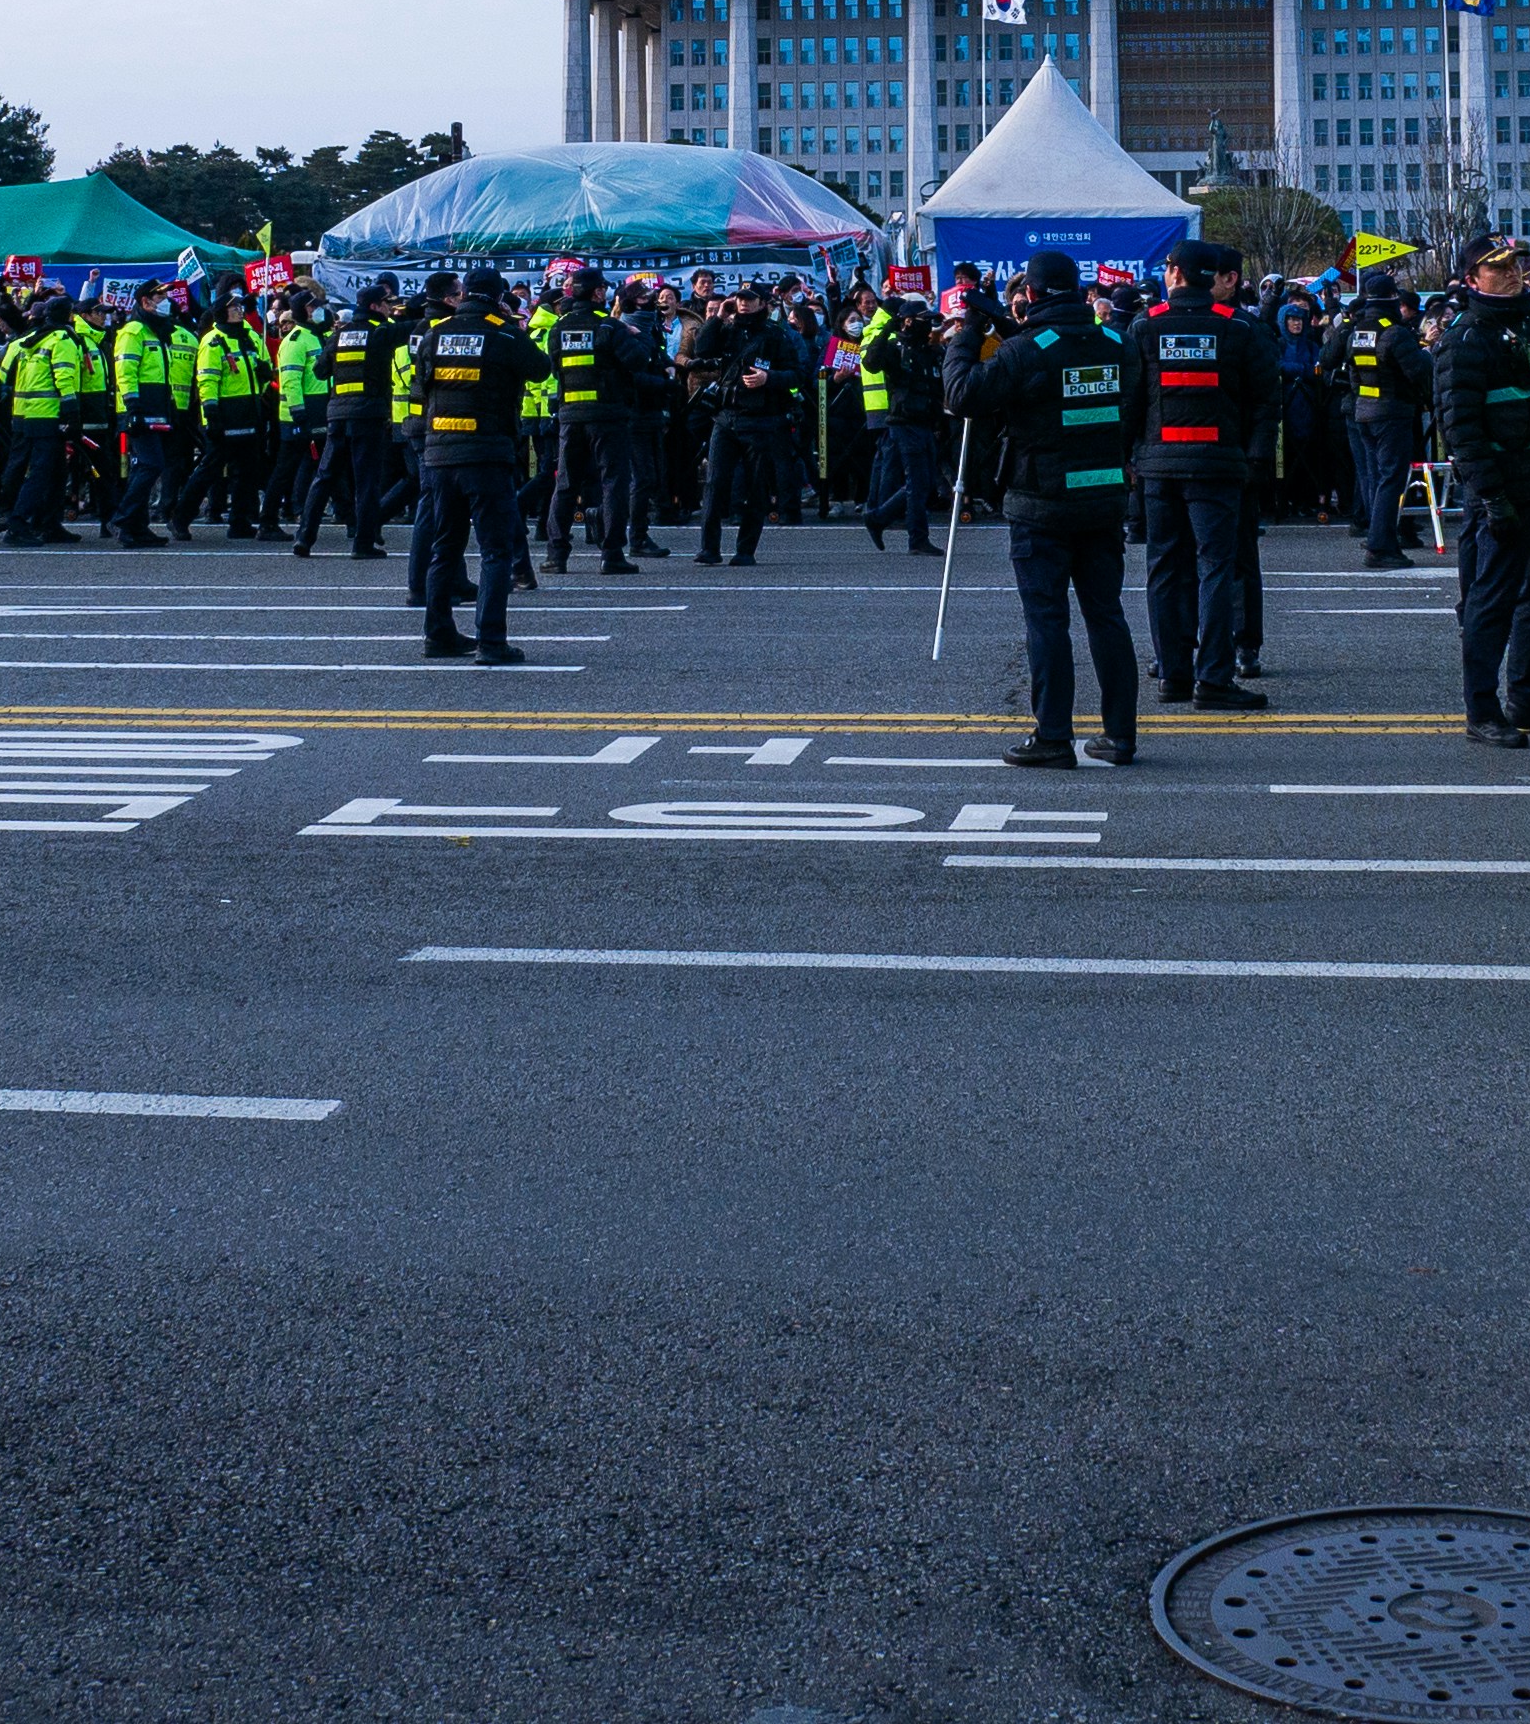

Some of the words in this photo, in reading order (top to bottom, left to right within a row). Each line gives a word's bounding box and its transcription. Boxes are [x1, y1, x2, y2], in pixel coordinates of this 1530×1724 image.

[1358, 243, 1397, 255] 22기-2
[9, 261, 36, 278] 탄핵
[441, 346, 477, 355] POLICE
[1165, 349, 1210, 359] POLICE
[1069, 382, 1114, 396] POLICE
